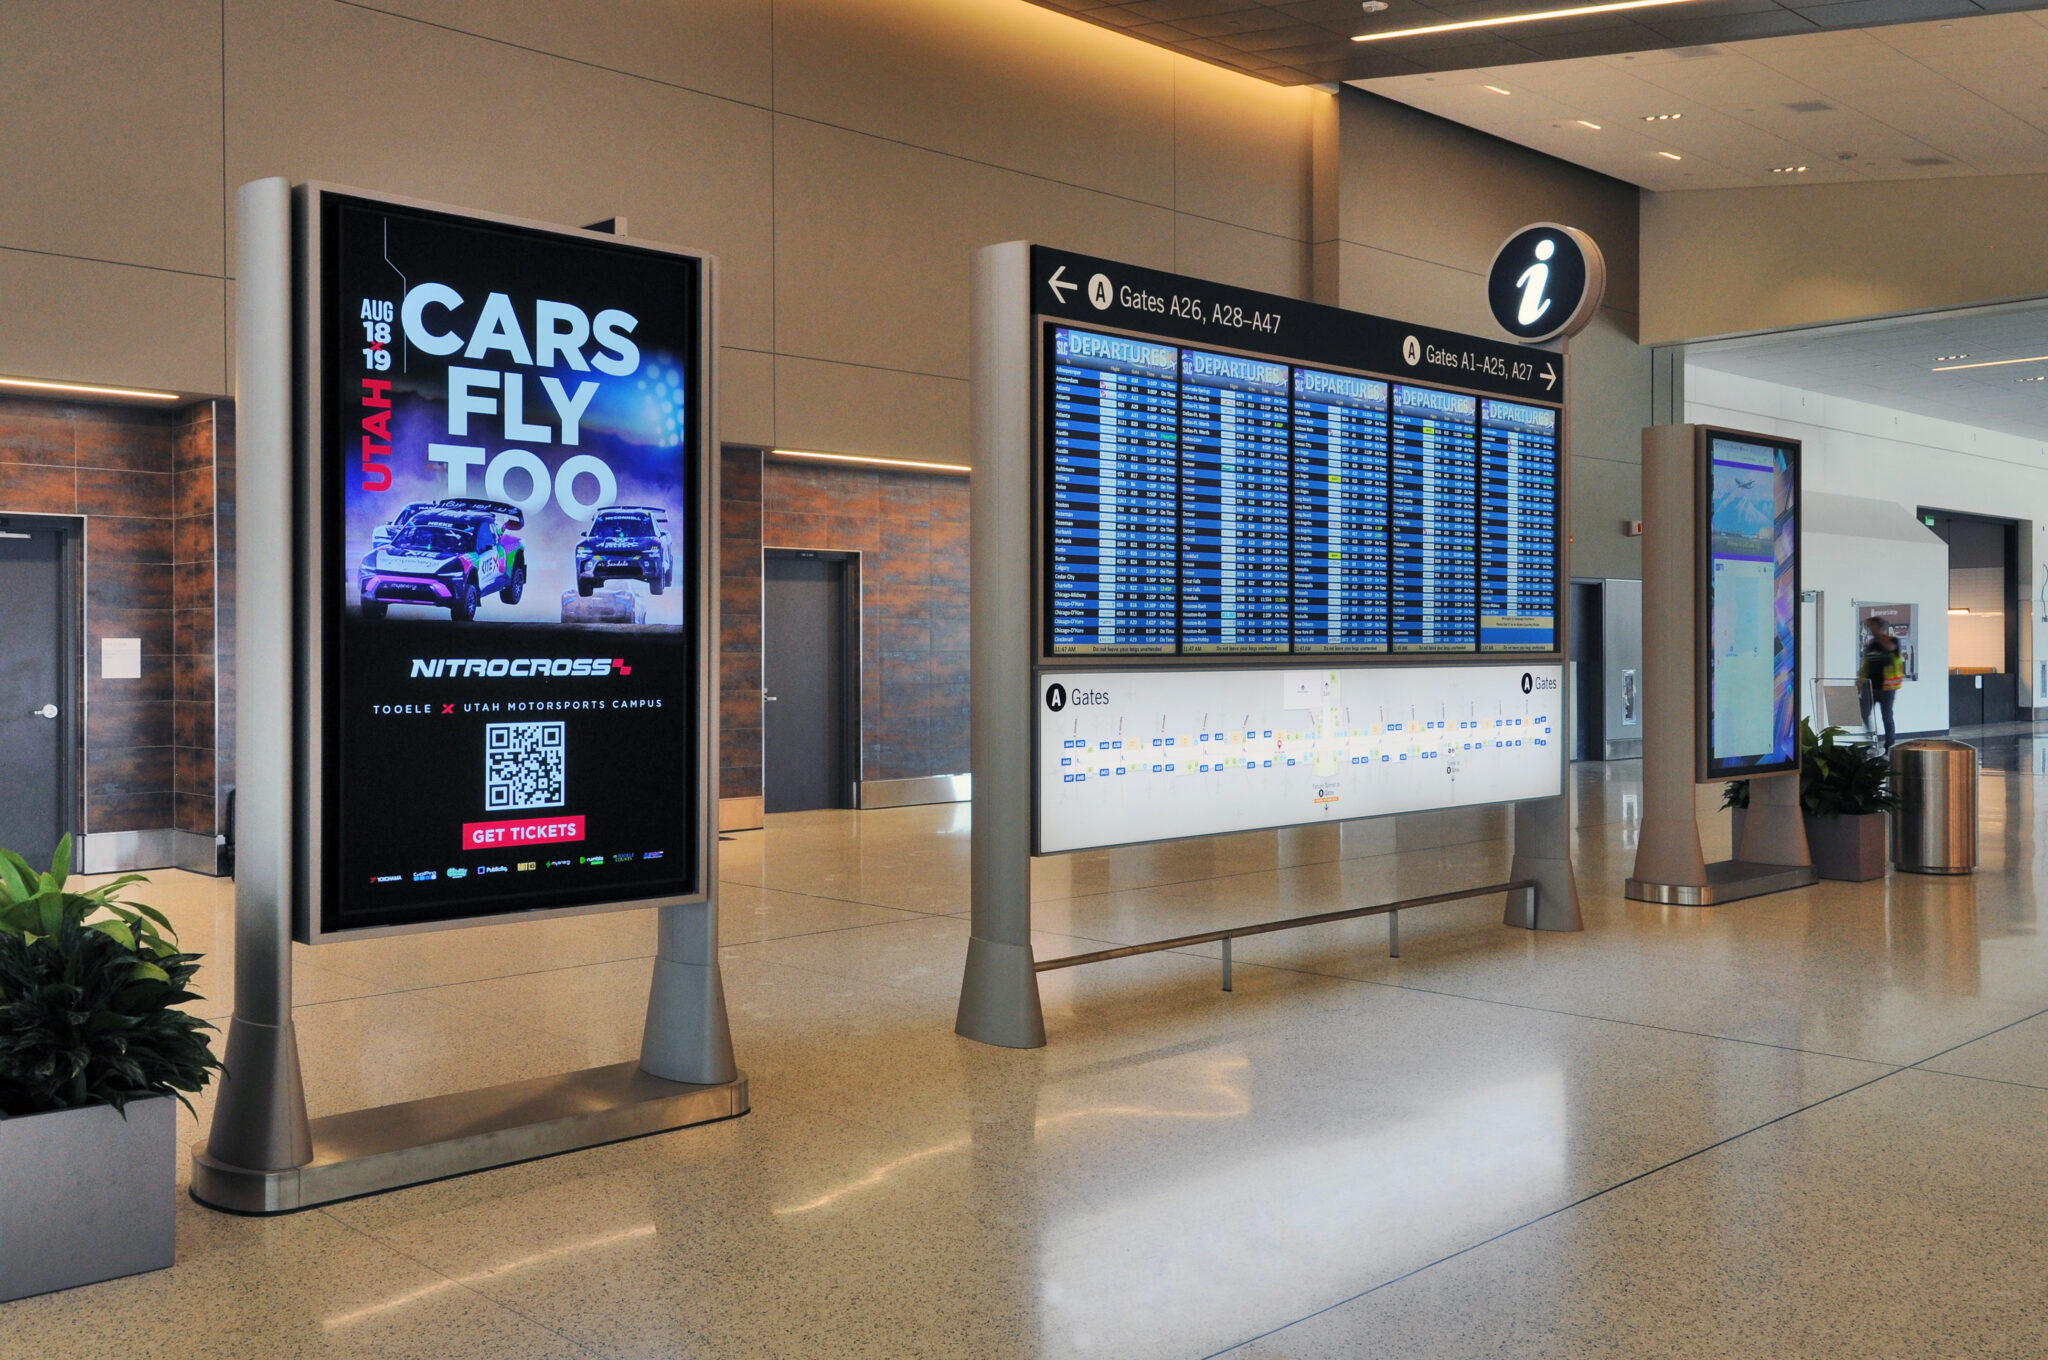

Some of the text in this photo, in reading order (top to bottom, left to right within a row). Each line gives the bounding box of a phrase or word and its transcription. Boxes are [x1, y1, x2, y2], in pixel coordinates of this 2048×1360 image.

[360, 298, 394, 322] AUG
[1120, 284, 1165, 314] Gates
[1170, 295, 1208, 323] A26,
[362, 320, 392, 345] 18
[402, 282, 640, 376] CARS
[362, 348, 392, 370] 19
[1070, 334, 1167, 367] DEPARTURES
[1195, 356, 1280, 384] DEPARTURES
[1426, 345, 1459, 368] Gates
[1511, 361, 1534, 382] A27
[1305, 374, 1380, 400] DEPARTURES
[448, 365, 600, 446] FLY
[1403, 390, 1468, 414] DEPARTURES
[362, 378, 392, 492] UTAH
[428, 442, 618, 522] TOO
[410, 658, 612, 678] NITROCROSS
[1535, 676, 1557, 690] Gates
[373, 704, 432, 714] TOOELE
[463, 702, 500, 712] UTAH
[508, 700, 606, 712] MOTORSPORTS
[612, 699, 663, 709] CAMPUS
[1071, 688, 1110, 706] Gates
[472, 822, 577, 844] GET TICKETS
